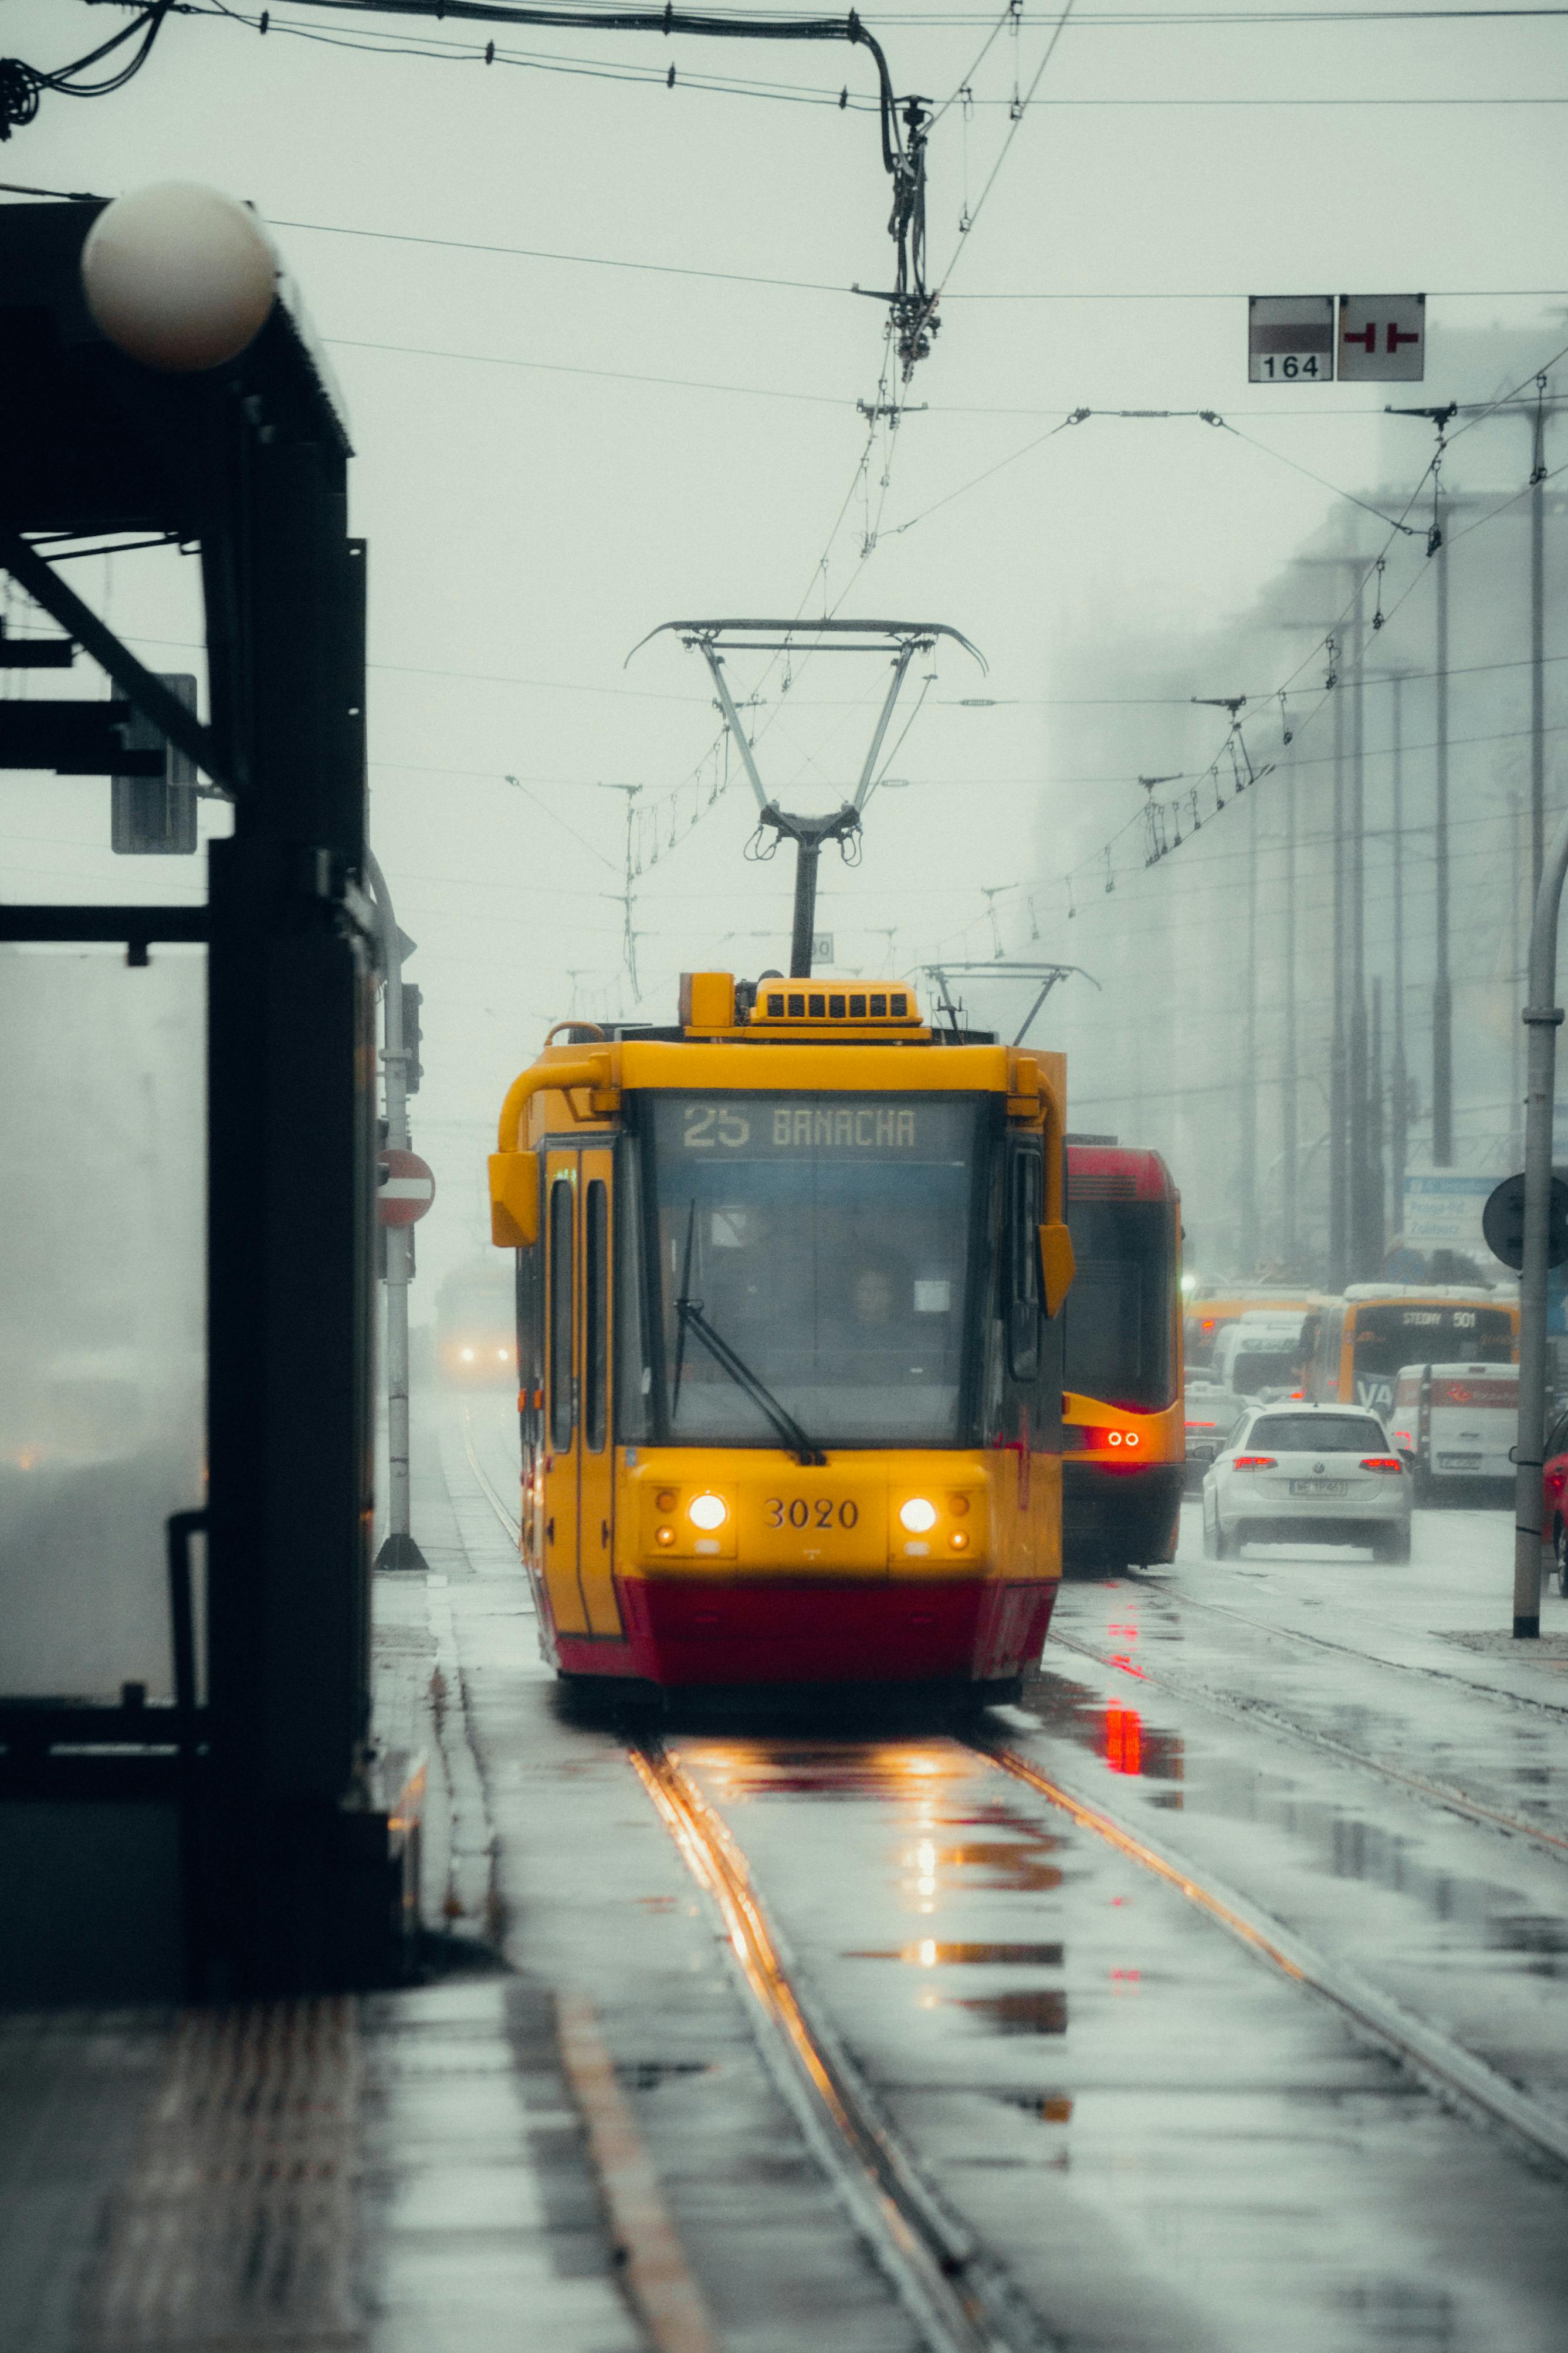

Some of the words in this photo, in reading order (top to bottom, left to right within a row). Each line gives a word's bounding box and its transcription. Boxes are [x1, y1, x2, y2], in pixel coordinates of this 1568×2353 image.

[1264, 356, 1318, 378] 164
[683, 1105, 750, 1147] 25
[773, 1109, 916, 1147] BANACHA
[1453, 1312, 1476, 1328] 501
[764, 1498, 858, 1529] 3020
